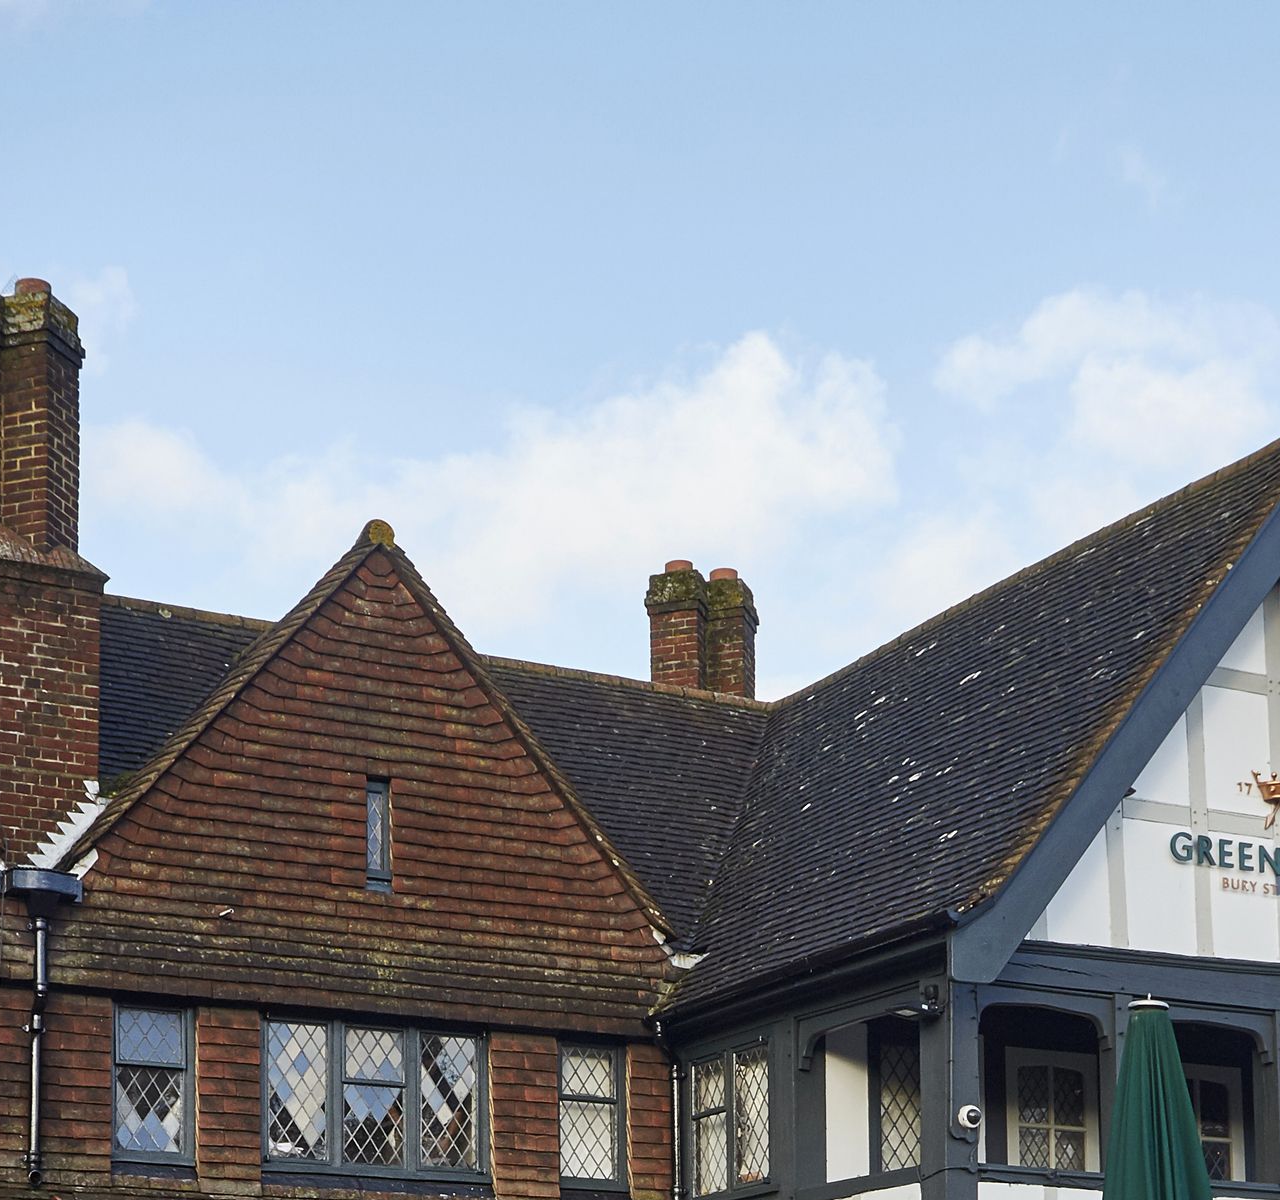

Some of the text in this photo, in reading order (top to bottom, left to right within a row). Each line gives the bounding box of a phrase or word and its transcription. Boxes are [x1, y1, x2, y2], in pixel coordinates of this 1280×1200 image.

[1236, 782, 1252, 795] 17
[1221, 877, 1257, 892] BURY
[1263, 883, 1279, 895] ST
